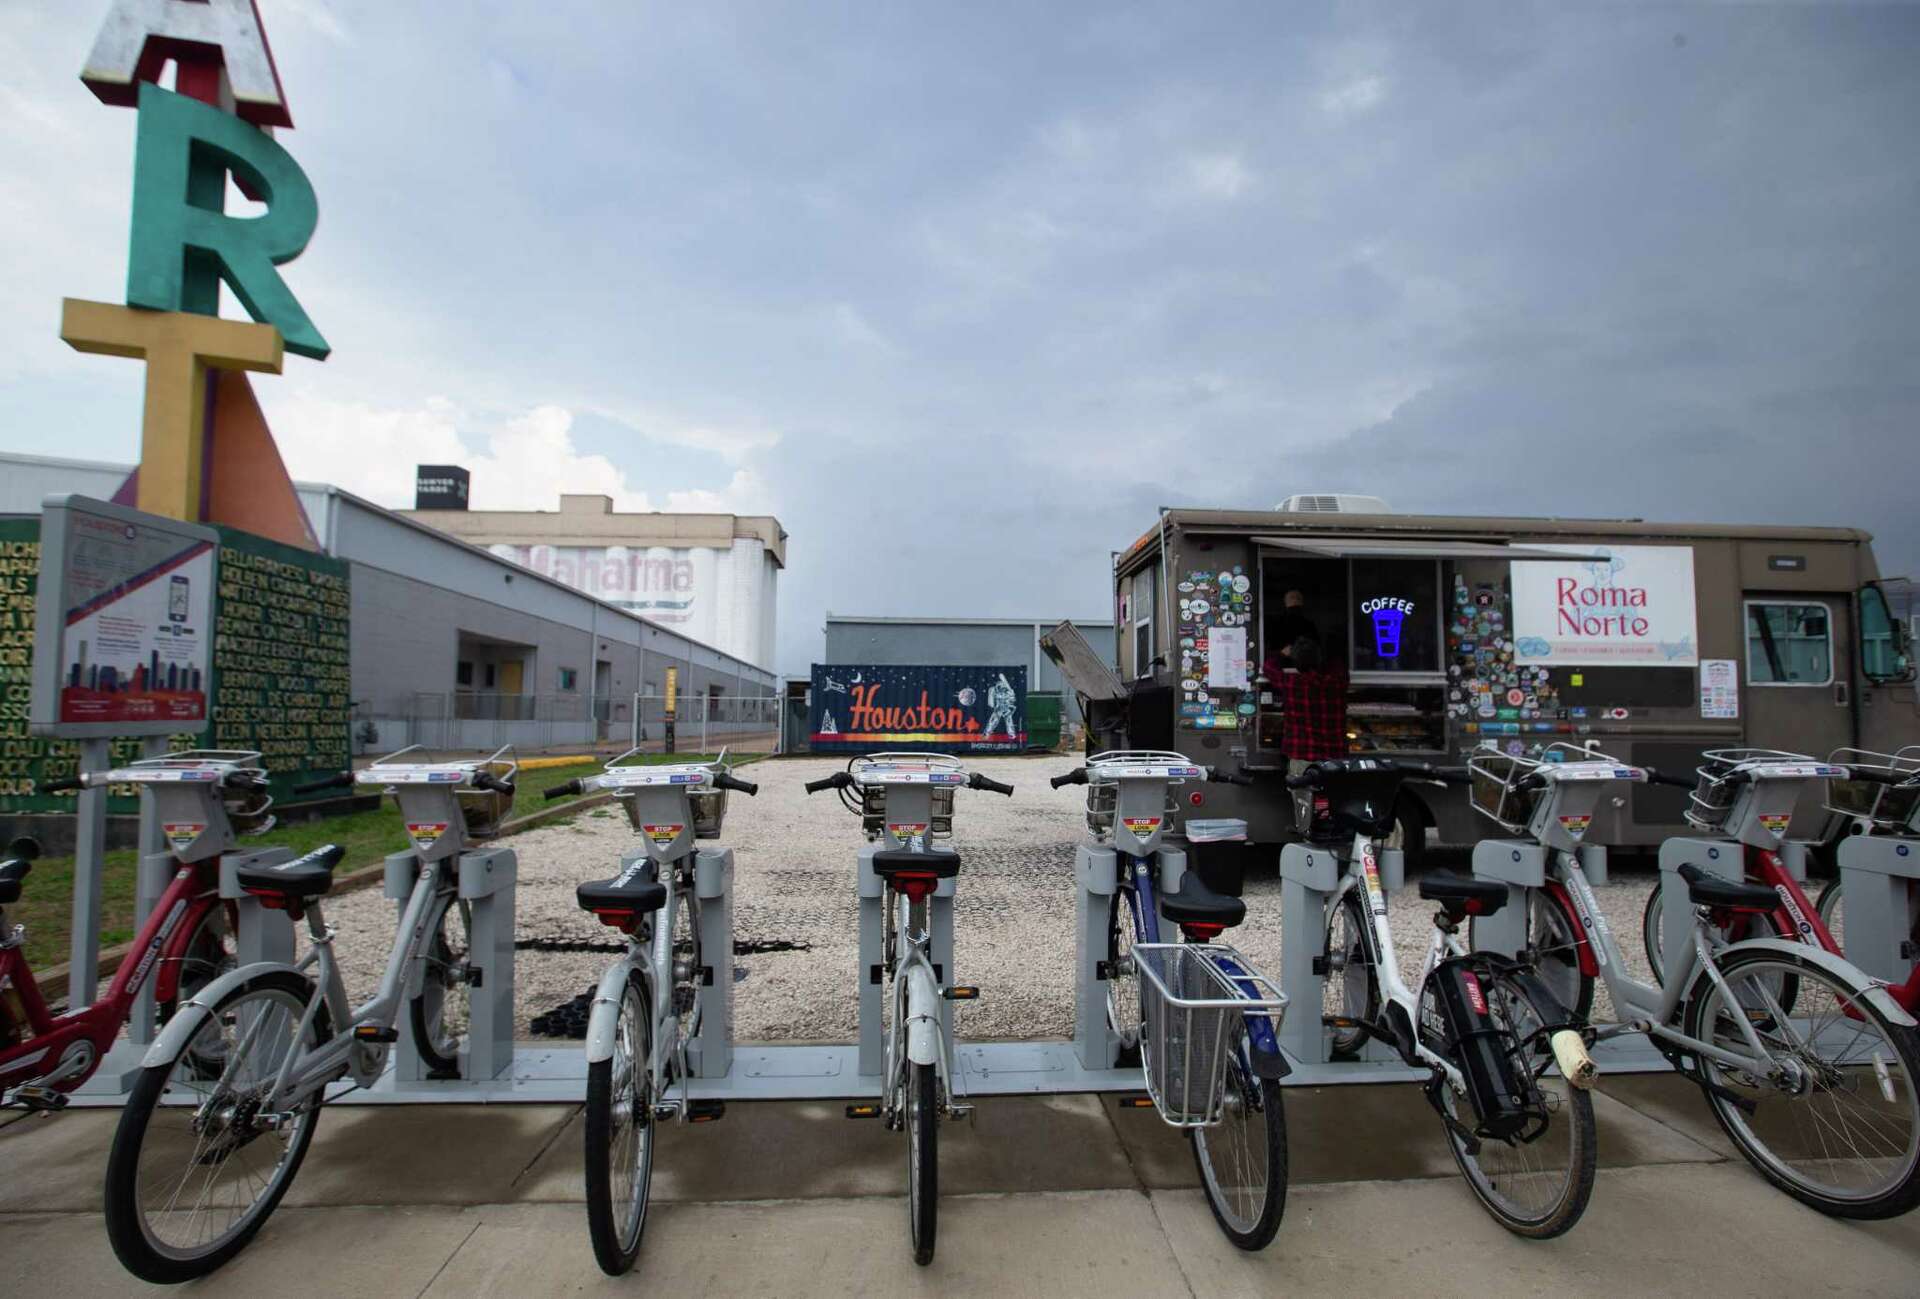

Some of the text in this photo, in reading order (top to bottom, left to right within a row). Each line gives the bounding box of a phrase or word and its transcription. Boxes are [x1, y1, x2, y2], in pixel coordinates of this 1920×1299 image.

[1361, 597, 1415, 616] COFFEE
[1557, 578, 1648, 607] Roma
[1557, 608, 1649, 637] Norte
[850, 683, 969, 731] Houston
[1777, 886, 1803, 922] HOUSTON
